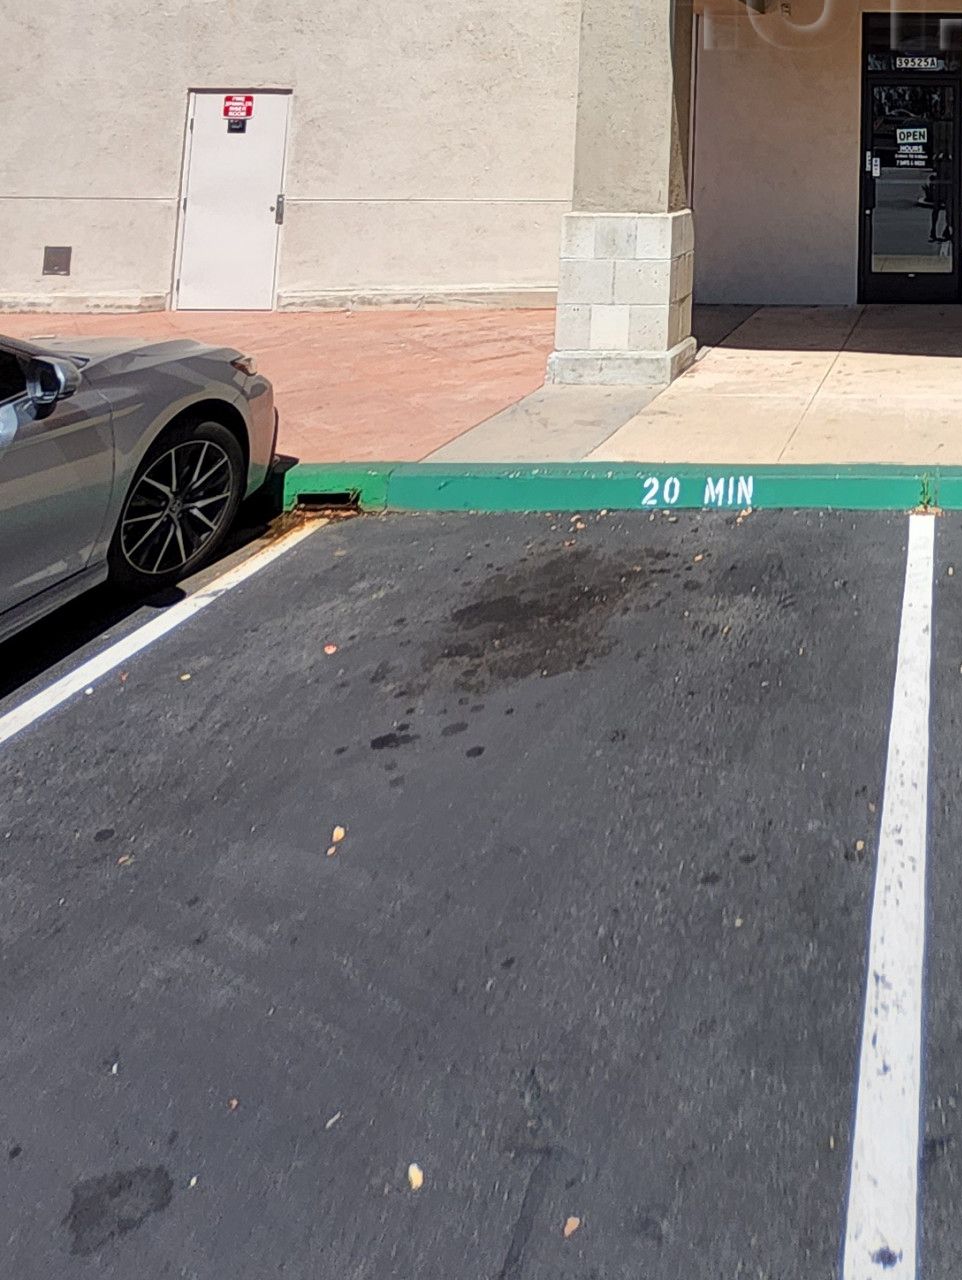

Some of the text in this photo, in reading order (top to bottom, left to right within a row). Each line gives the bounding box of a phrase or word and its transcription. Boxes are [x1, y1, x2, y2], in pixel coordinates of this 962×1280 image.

[897, 58, 935, 68] 39525A
[898, 130, 926, 141] OPEN
[641, 475, 753, 506] 20 MIN
